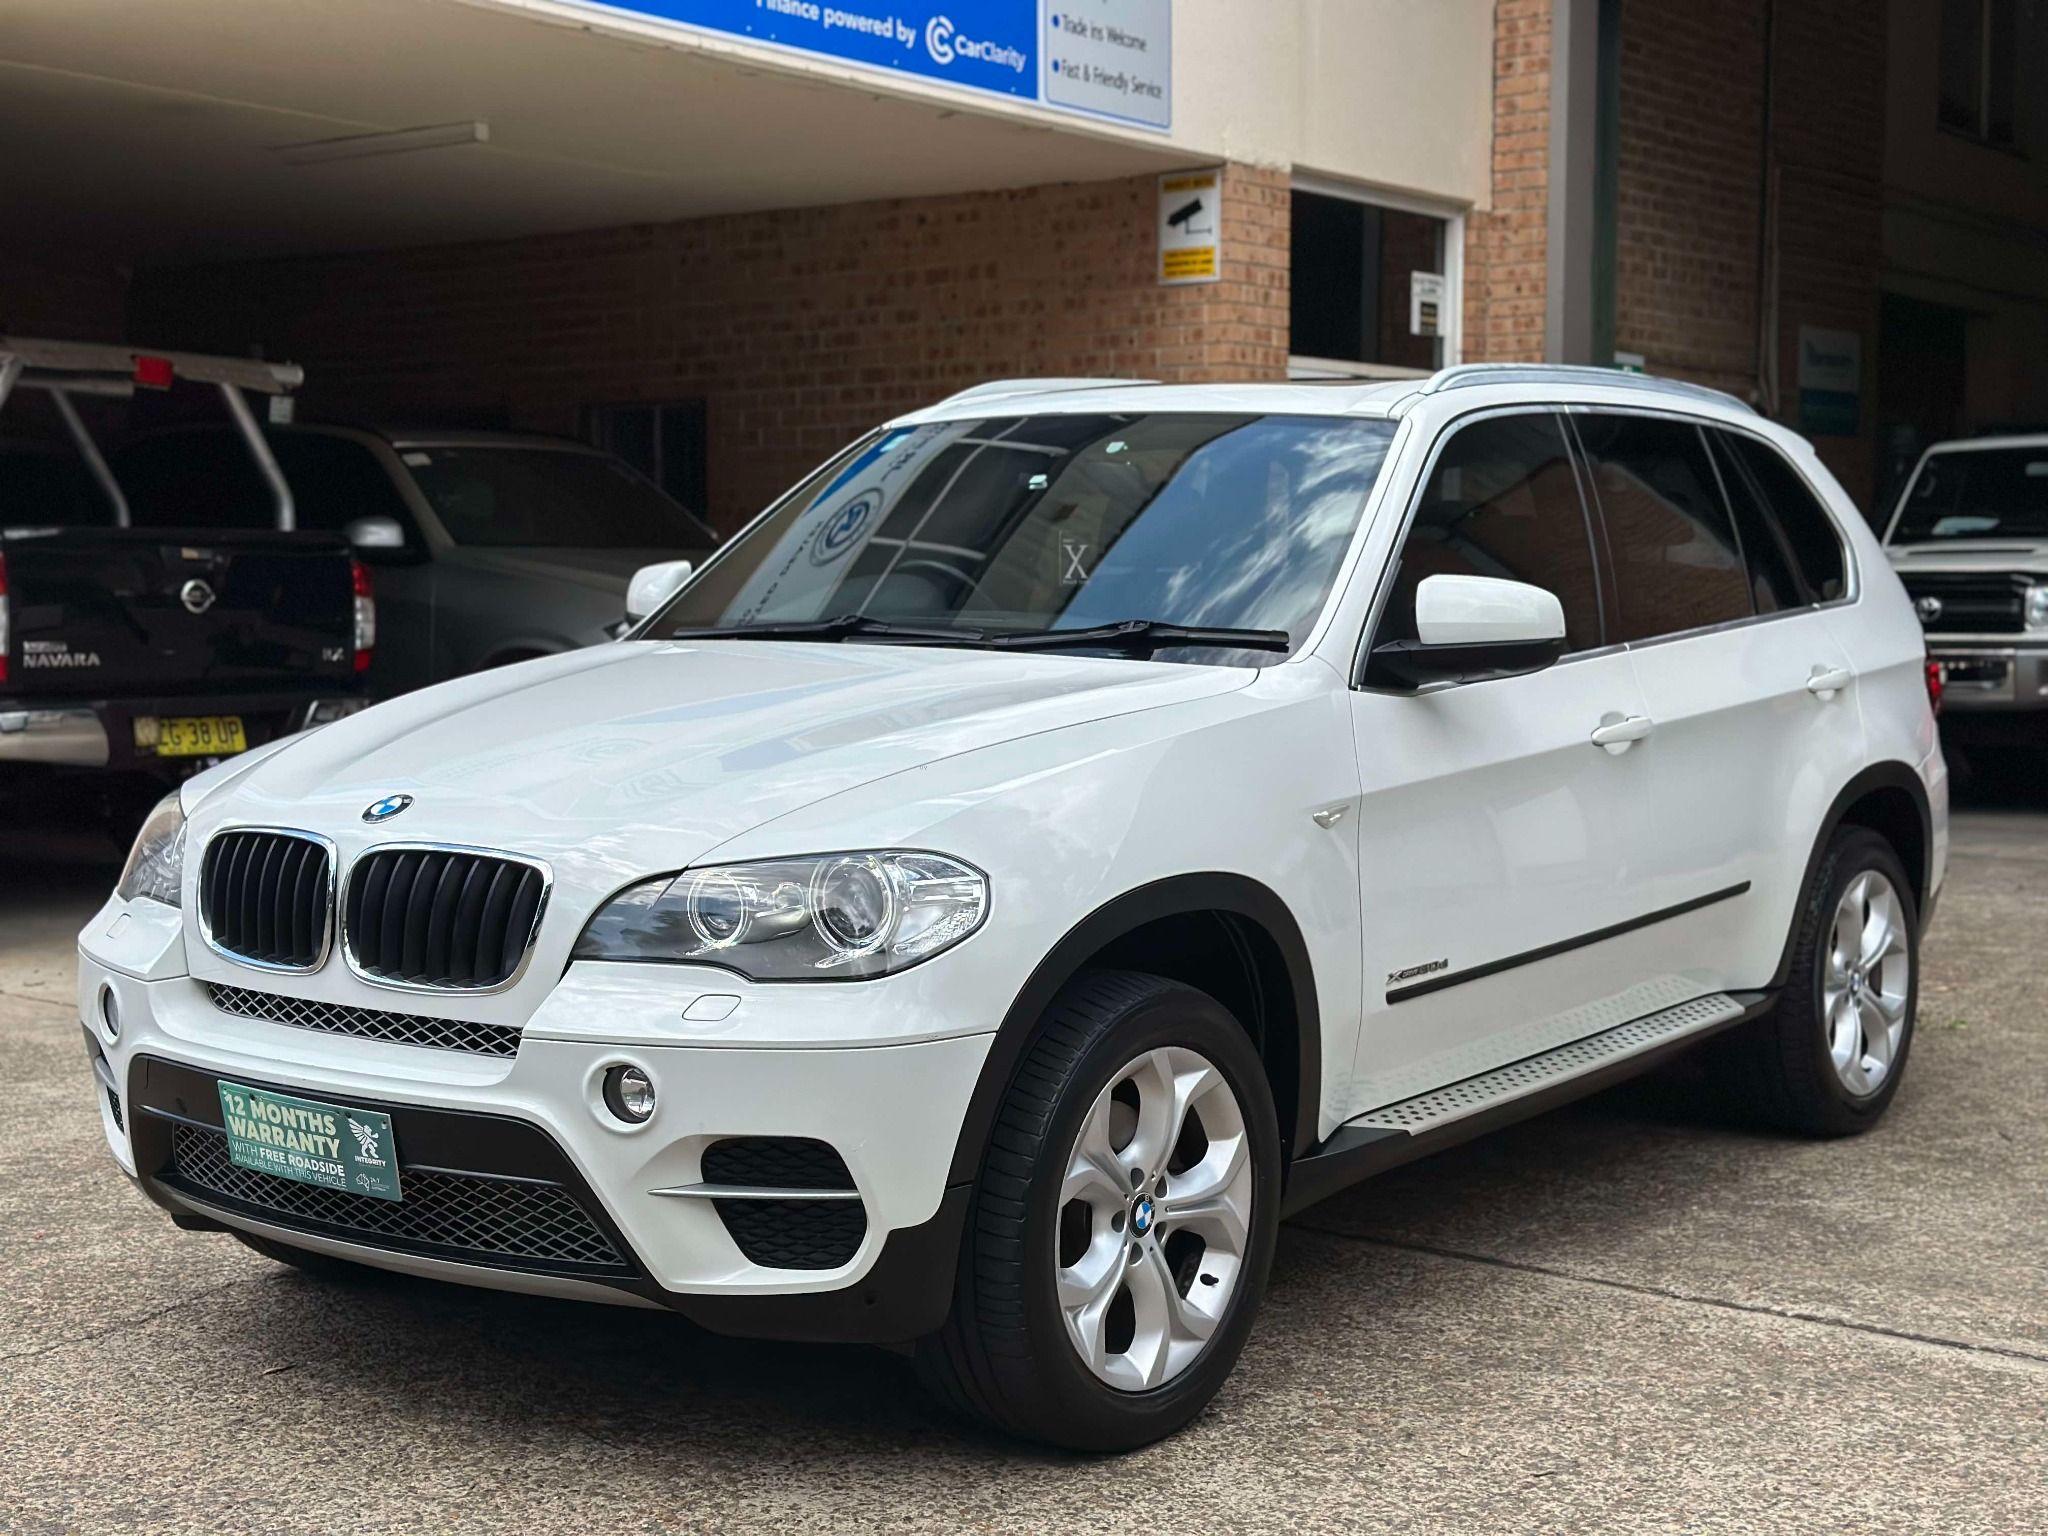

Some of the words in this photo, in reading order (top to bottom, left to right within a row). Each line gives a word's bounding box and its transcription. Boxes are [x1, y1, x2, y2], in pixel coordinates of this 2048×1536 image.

[823, 8, 893, 38] powered
[896, 18, 916, 49] by
[1062, 14, 1087, 38] Trade
[1106, 26, 1147, 52] Welcome
[954, 35, 1027, 73] CarClarity
[1062, 59, 1080, 80] Fast
[1083, 63, 1090, 82] &
[1093, 66, 1128, 95] Friendly
[1131, 75, 1162, 99] Service
[23, 651, 101, 668] NAVARA
[187, 721, 211, 745] 38
[224, 1093, 246, 1116] 12
[249, 1099, 337, 1136] MONTHS
[228, 1115, 340, 1158] WARRANTY
[232, 1140, 258, 1154] WITH
[260, 1148, 287, 1164] FREE
[288, 1154, 345, 1177] ROADSIDE
[234, 1153, 273, 1171] AVAILABLE
[273, 1161, 294, 1175] WITH
[295, 1166, 312, 1179] THIS
[312, 1171, 347, 1188] VEHICLE
[354, 1155, 386, 1167] INTEGRITY
